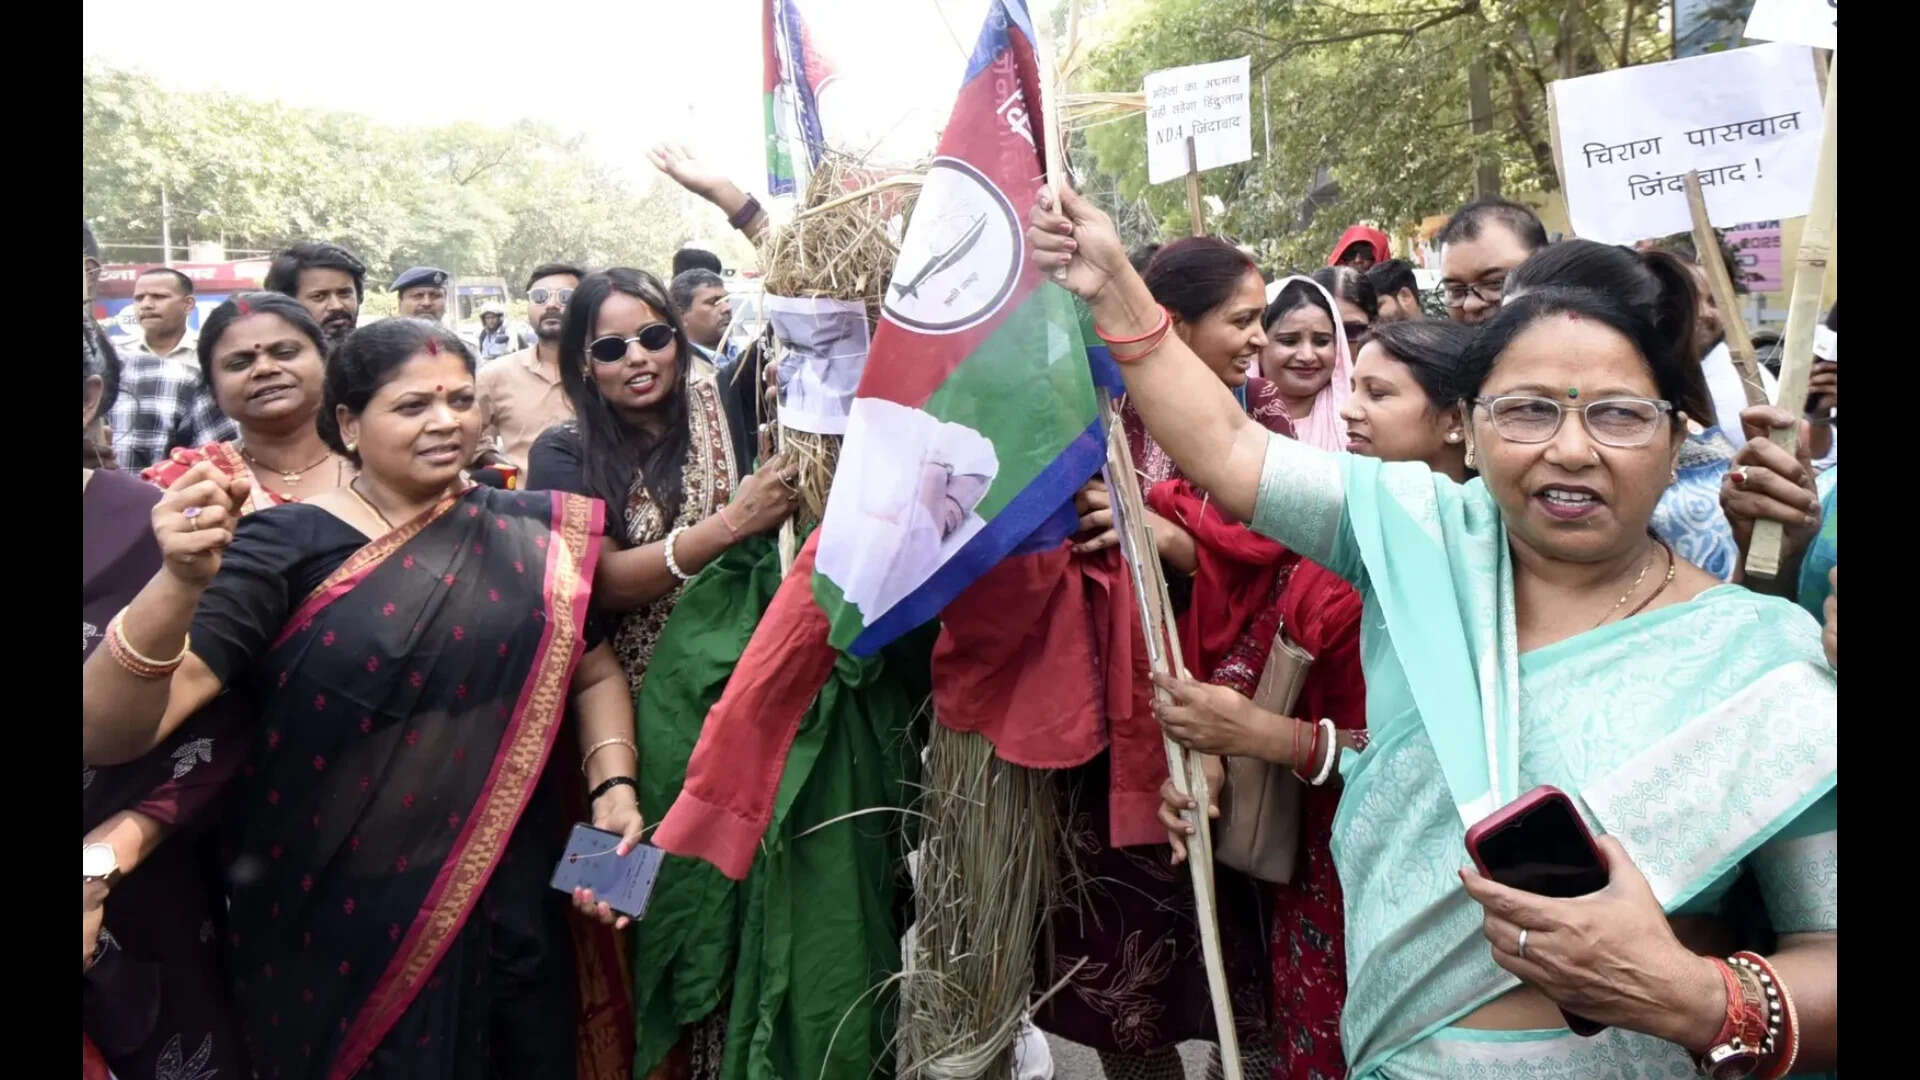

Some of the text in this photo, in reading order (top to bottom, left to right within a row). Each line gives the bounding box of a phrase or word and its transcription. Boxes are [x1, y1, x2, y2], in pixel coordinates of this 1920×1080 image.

[1156, 115, 1241, 145] NDA जिंदाबाद
[1582, 111, 1801, 168] चिराग पासवान
[1628, 162, 1747, 200] जिंदबाद
